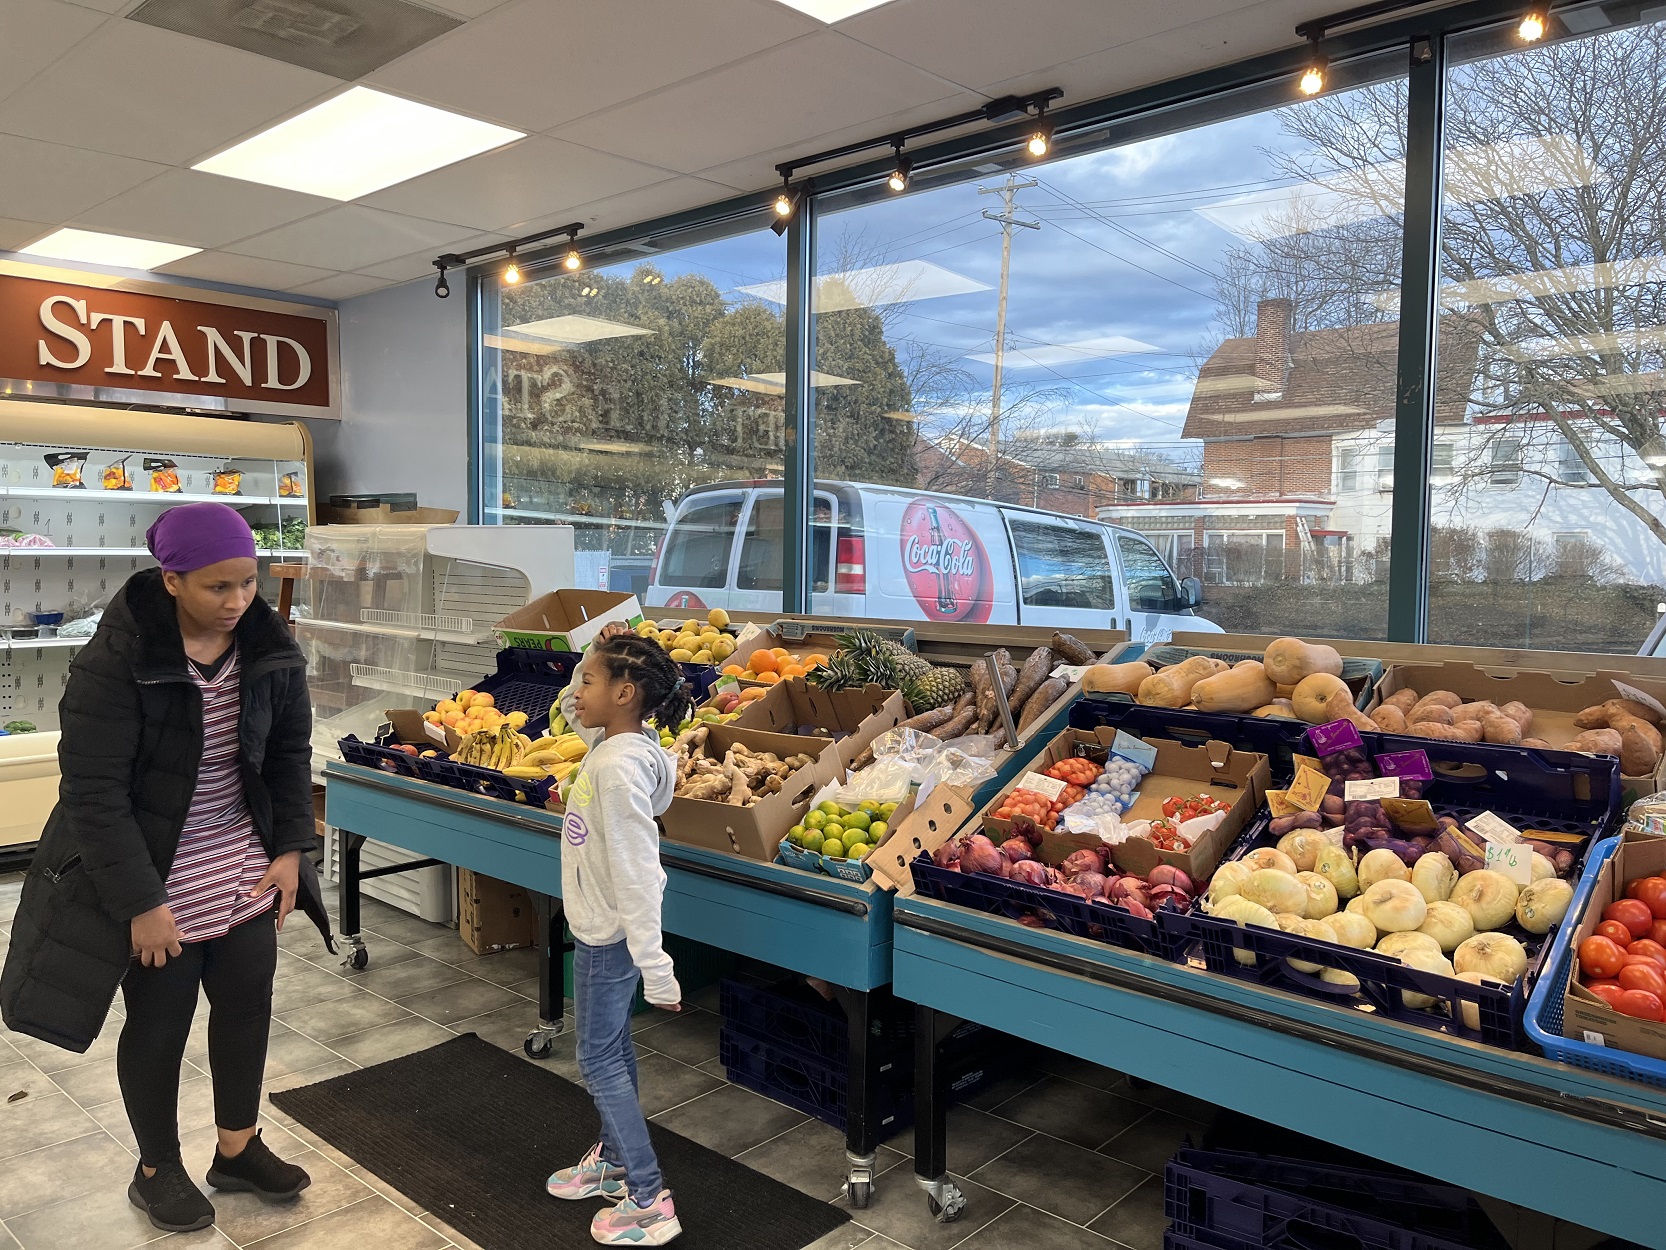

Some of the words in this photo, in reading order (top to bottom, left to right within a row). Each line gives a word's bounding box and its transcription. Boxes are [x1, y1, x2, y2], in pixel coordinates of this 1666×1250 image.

[38, 295, 312, 391] STAND
[904, 535, 975, 577] Coca-Cola
[513, 636, 544, 651] PEARS
